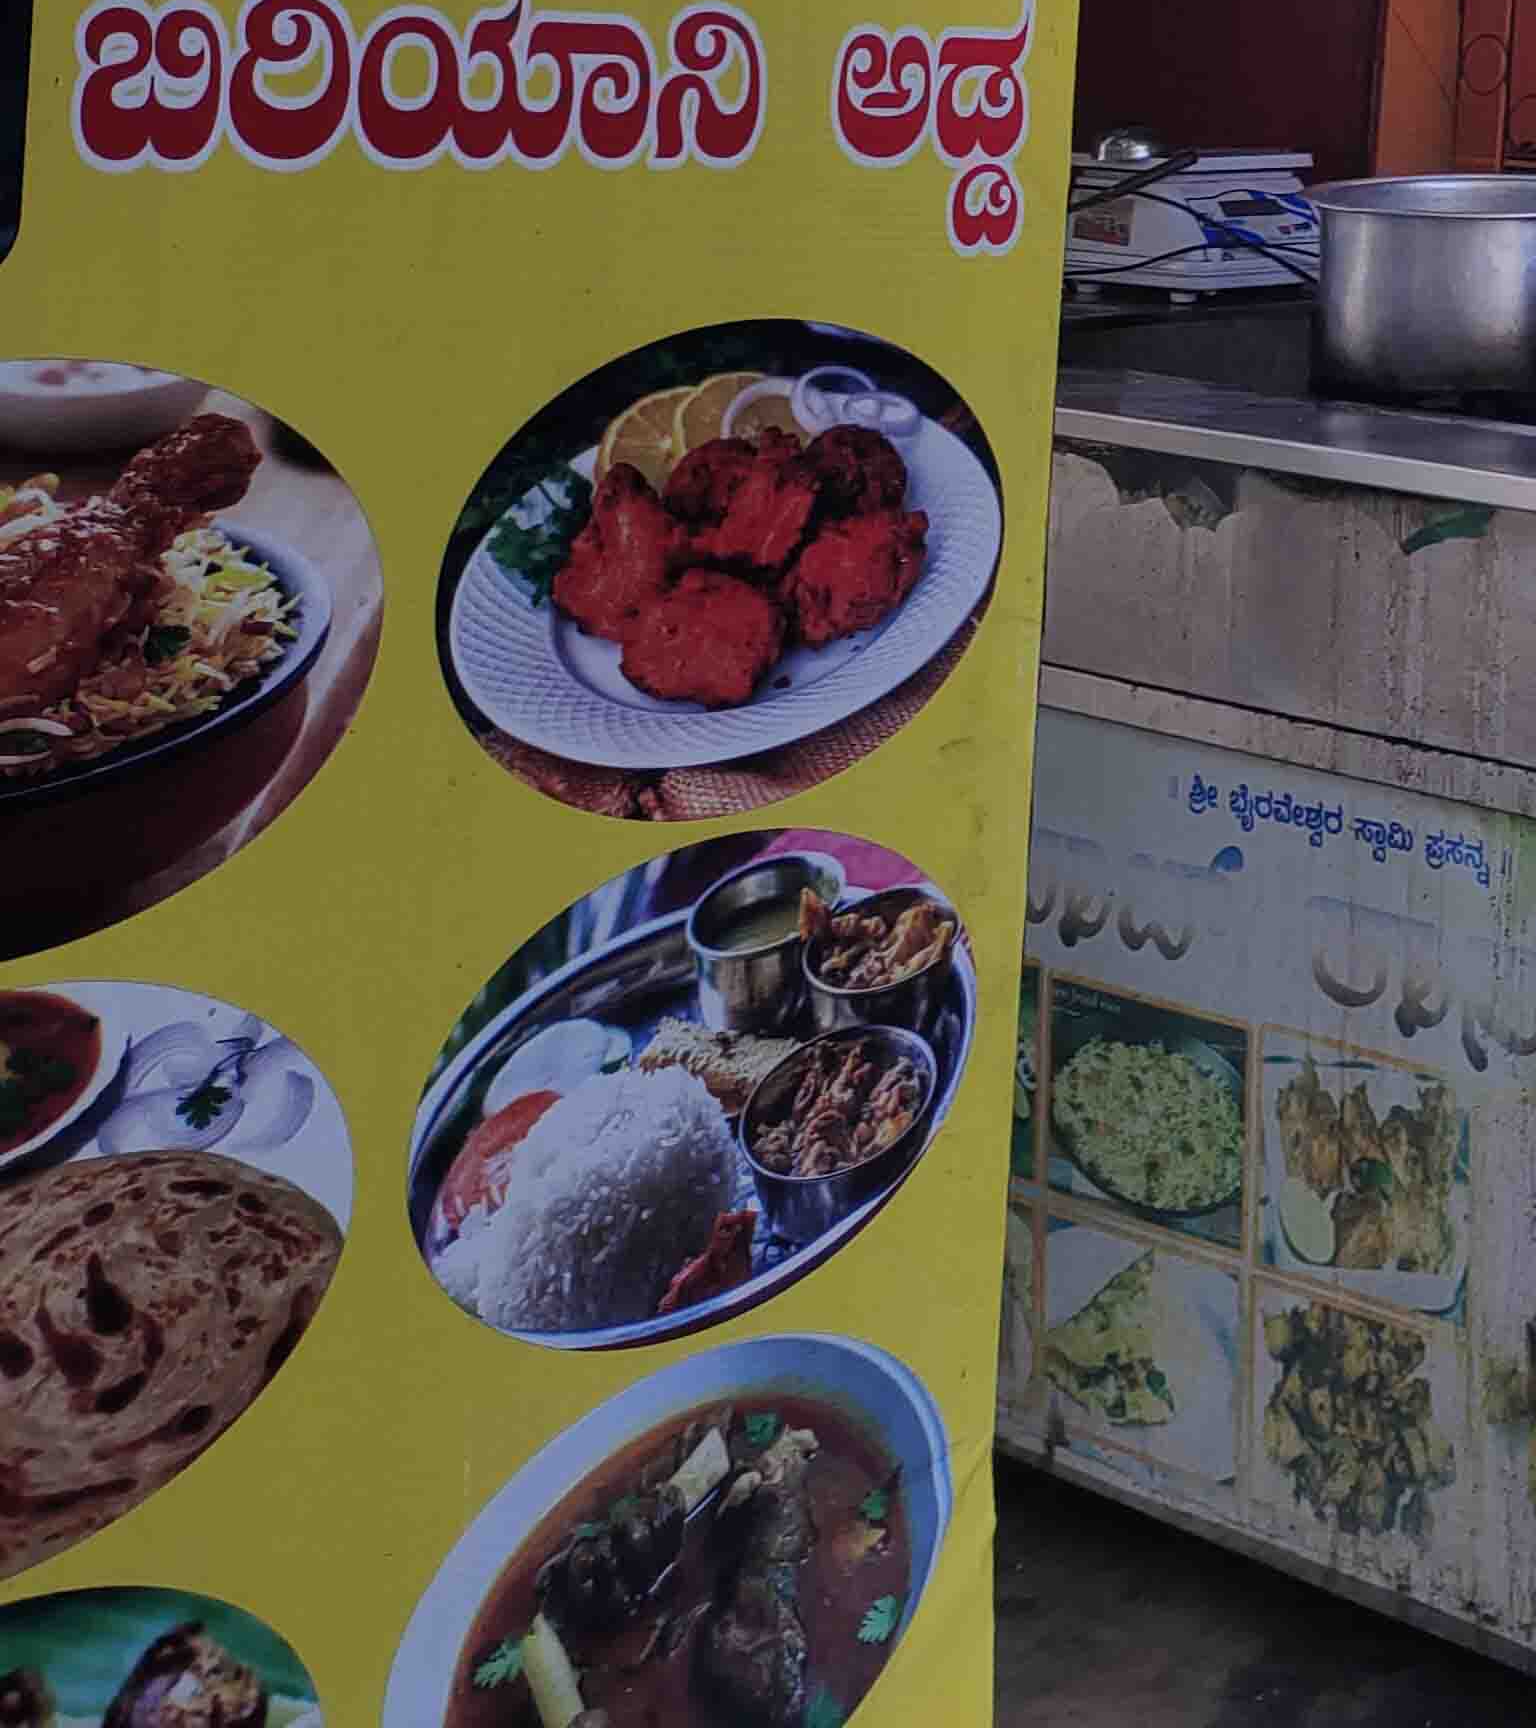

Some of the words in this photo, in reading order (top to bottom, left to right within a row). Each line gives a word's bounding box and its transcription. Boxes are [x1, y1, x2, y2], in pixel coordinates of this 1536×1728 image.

[1189, 773, 1218, 814] ಶ್ರೀ
[1353, 817, 1414, 863] ಸ್ವಾಮಿ
[1424, 831, 1490, 888] ಪ್ರಸನ್ನ
